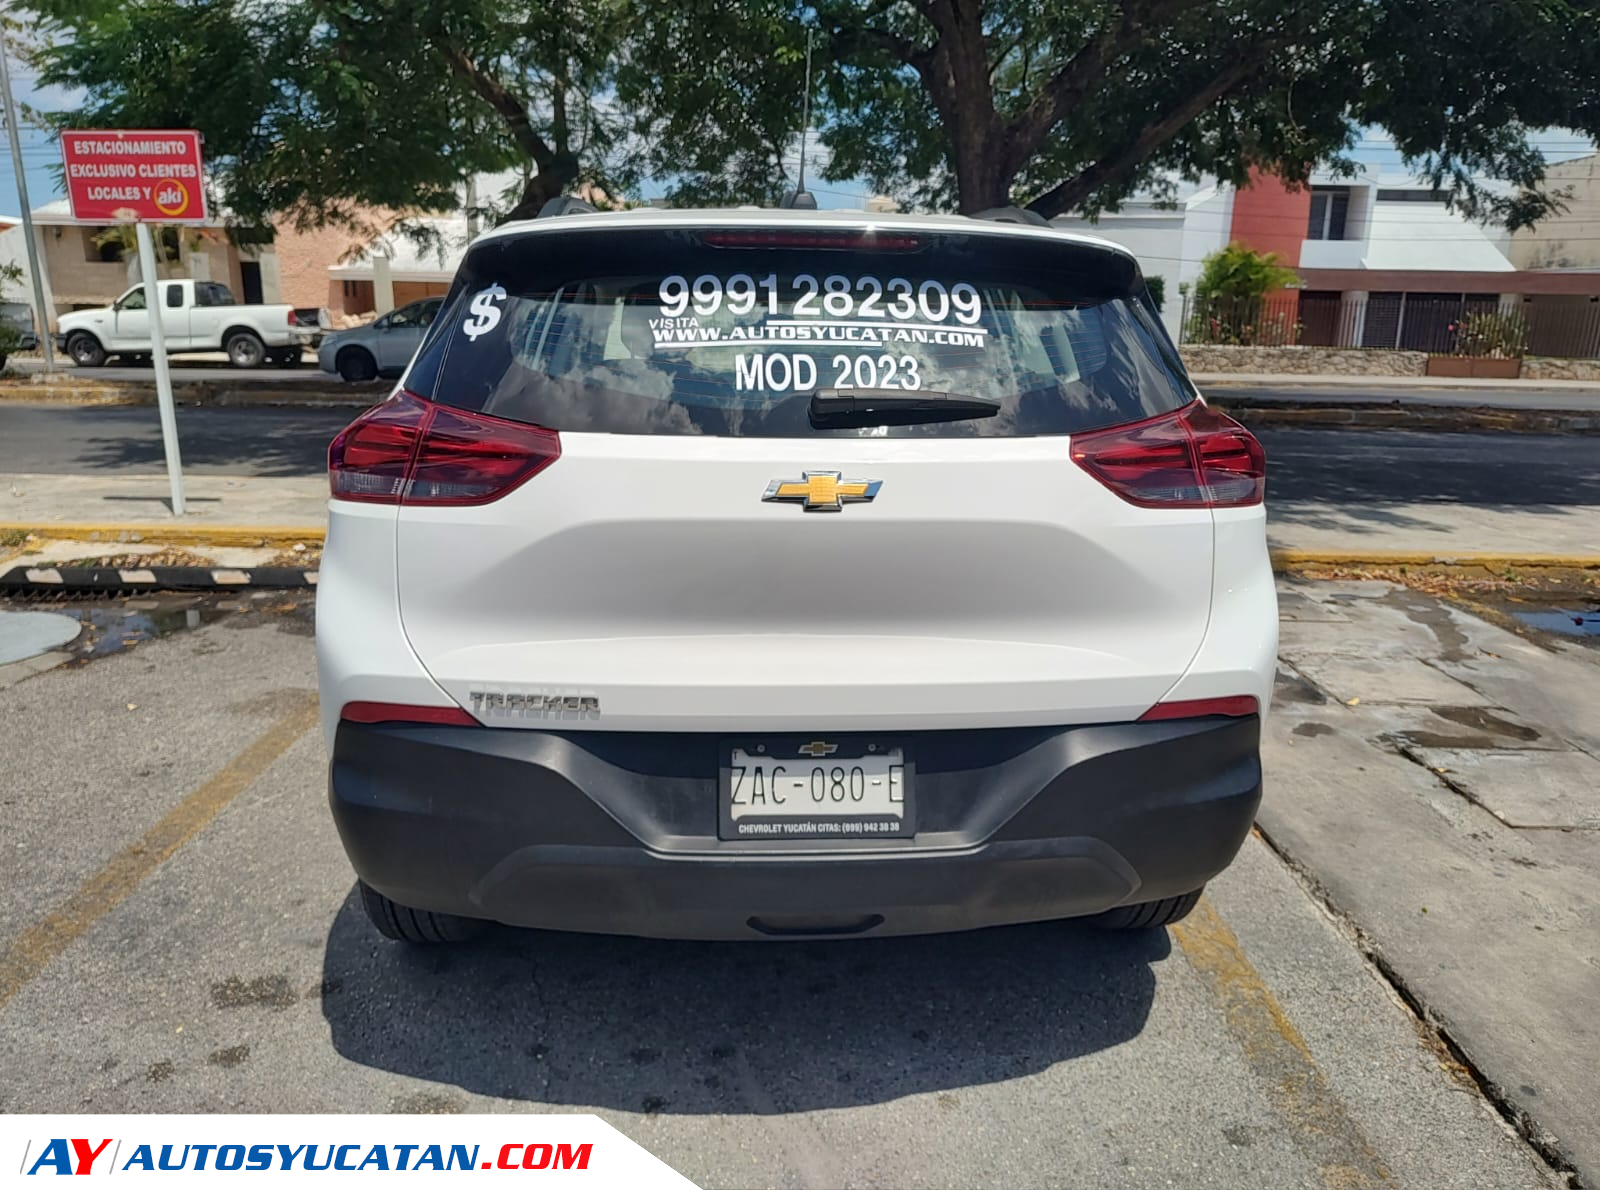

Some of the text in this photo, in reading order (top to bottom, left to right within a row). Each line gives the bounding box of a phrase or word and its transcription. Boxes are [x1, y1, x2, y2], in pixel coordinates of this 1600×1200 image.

[73, 140, 186, 155] ESTACIONAMIENTO
[70, 164, 197, 178] EXCLUSIVO CLIENTES
[87, 186, 182, 205] LOCALES Y aki
[658, 273, 983, 325] 9991282309
[463, 282, 507, 342] $
[648, 317, 700, 330] VISITA
[652, 325, 986, 348] WWW.AUTOSYUCATAN.COM
[735, 353, 922, 392] MOD 2023
[469, 691, 601, 716] TRACKER
[731, 764, 904, 806] ZAC-080-E
[738, 823, 782, 834] CHEVROLET
[783, 821, 817, 833] YUCATÁN
[818, 822, 841, 833] CITAS:
